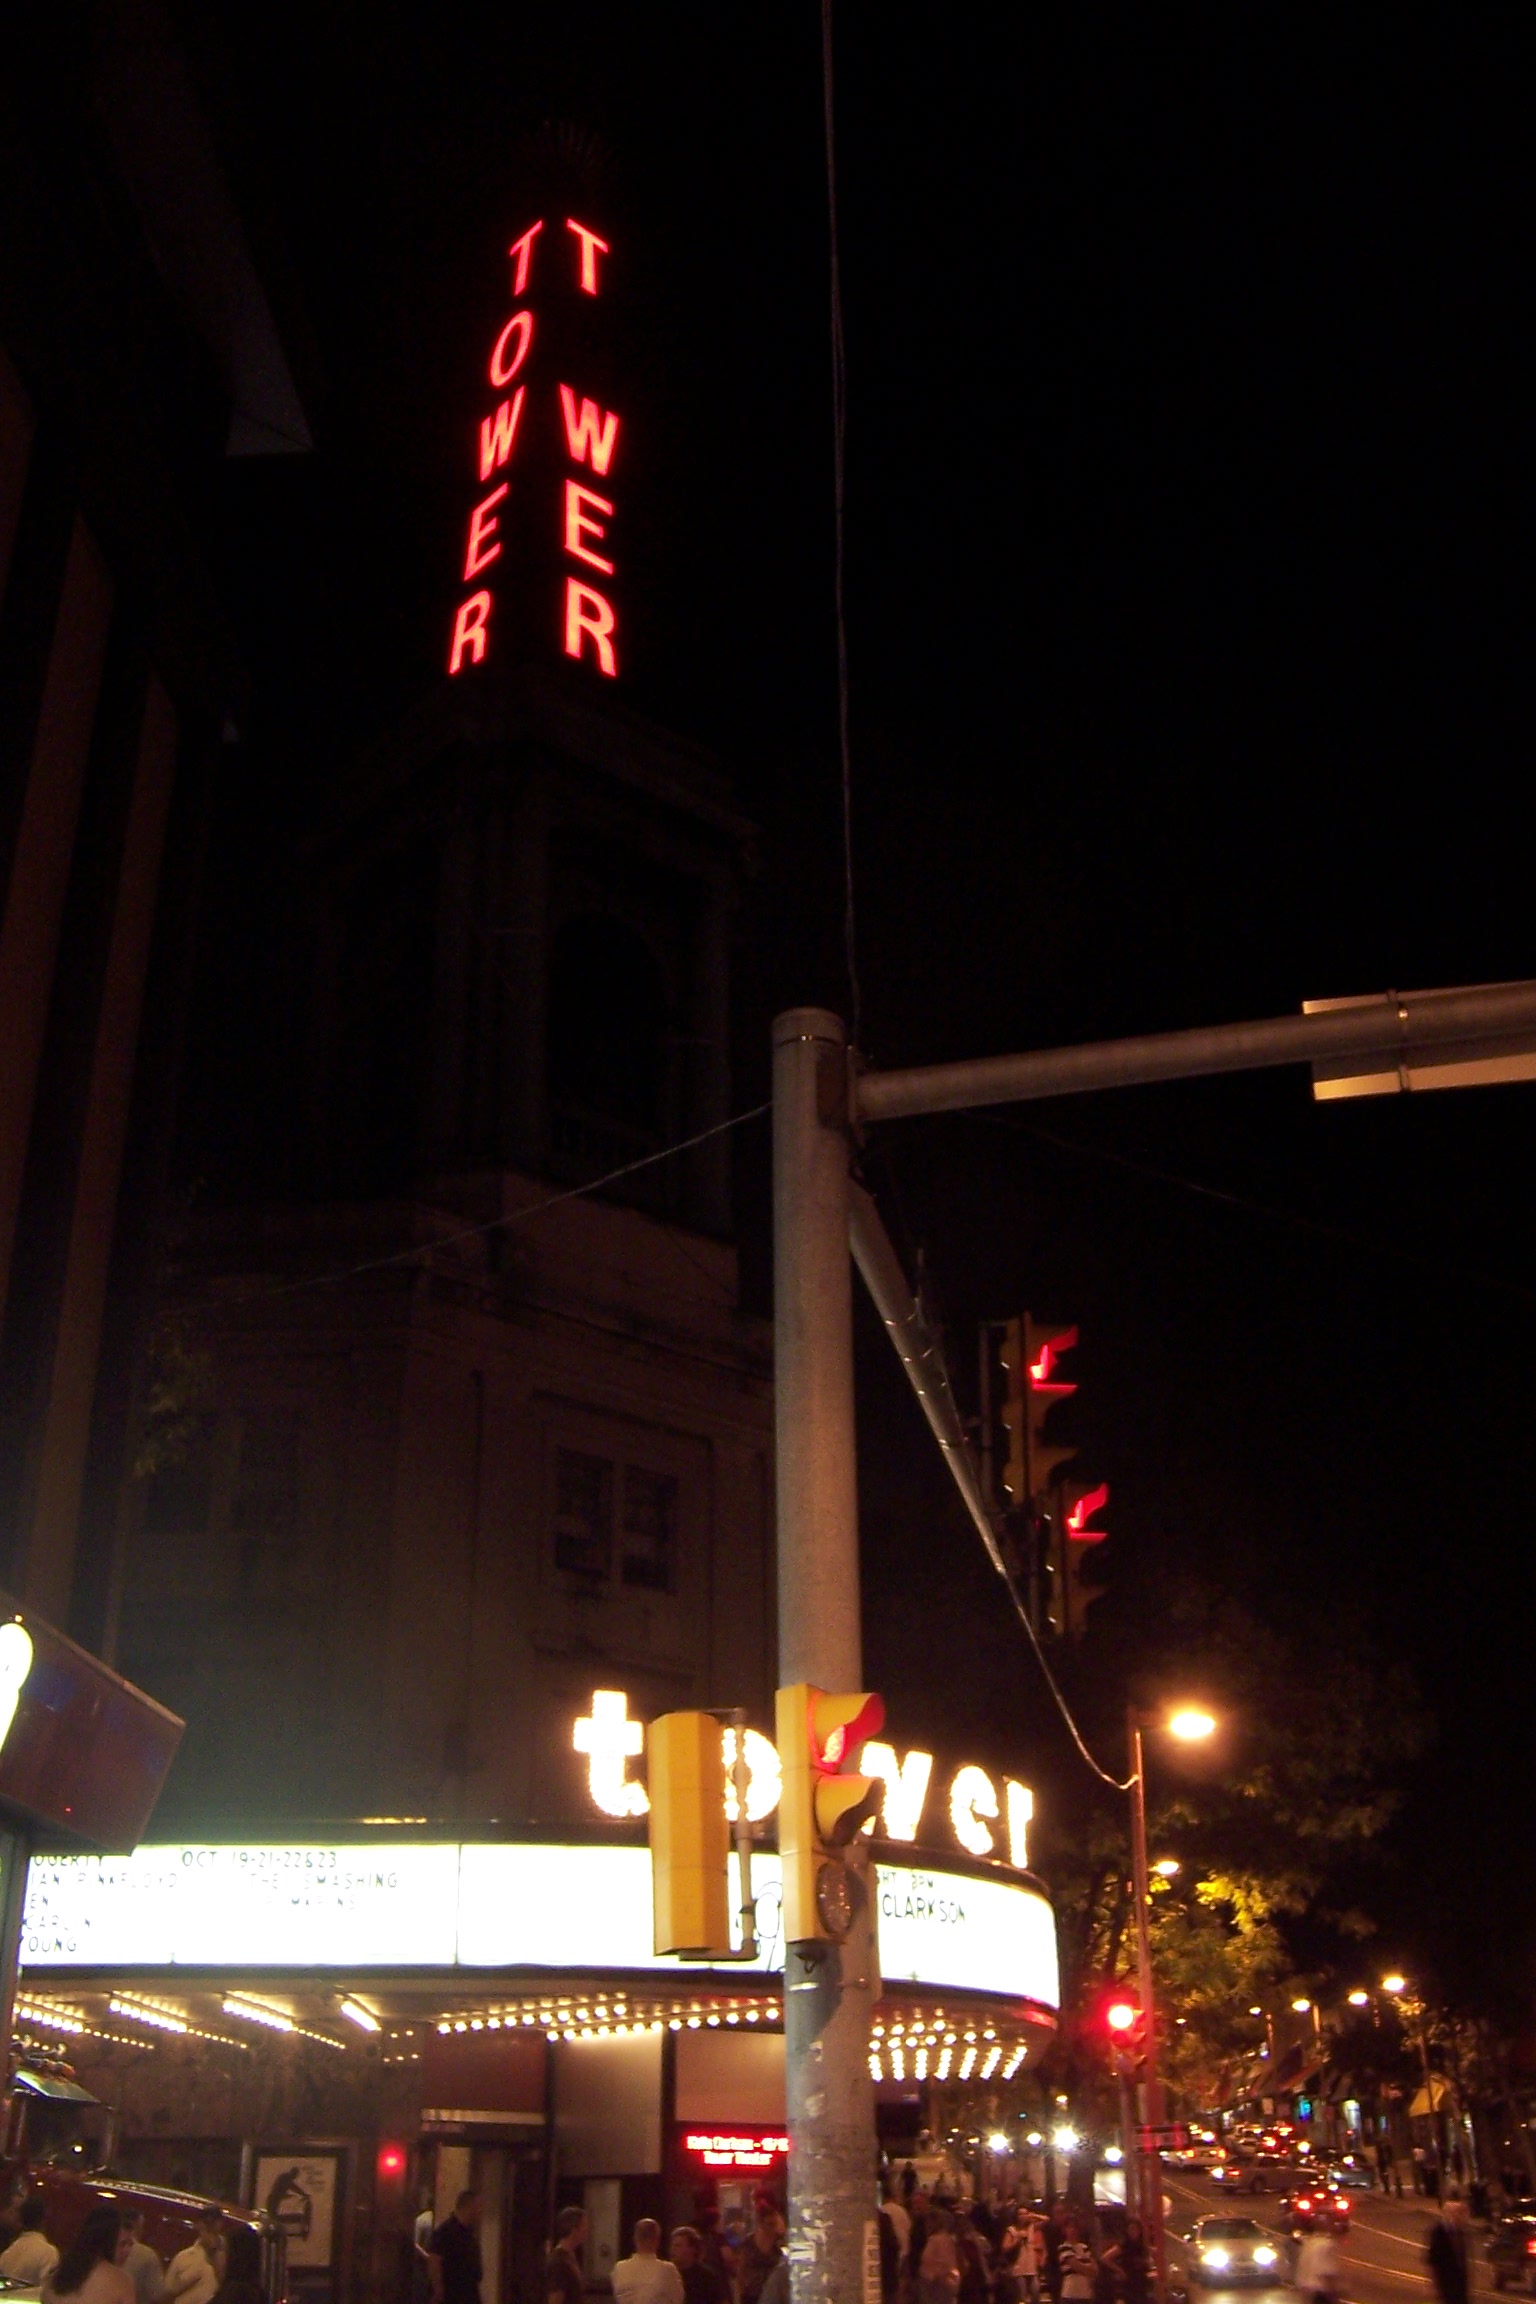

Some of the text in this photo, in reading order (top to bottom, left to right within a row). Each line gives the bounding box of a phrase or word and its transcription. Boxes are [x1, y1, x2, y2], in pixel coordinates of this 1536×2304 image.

[449, 218, 544, 676] TOWER
[559, 216, 620, 678] TWER
[181, 1850, 218, 1867] OCT
[882, 1892, 967, 1924] CLARKSON
